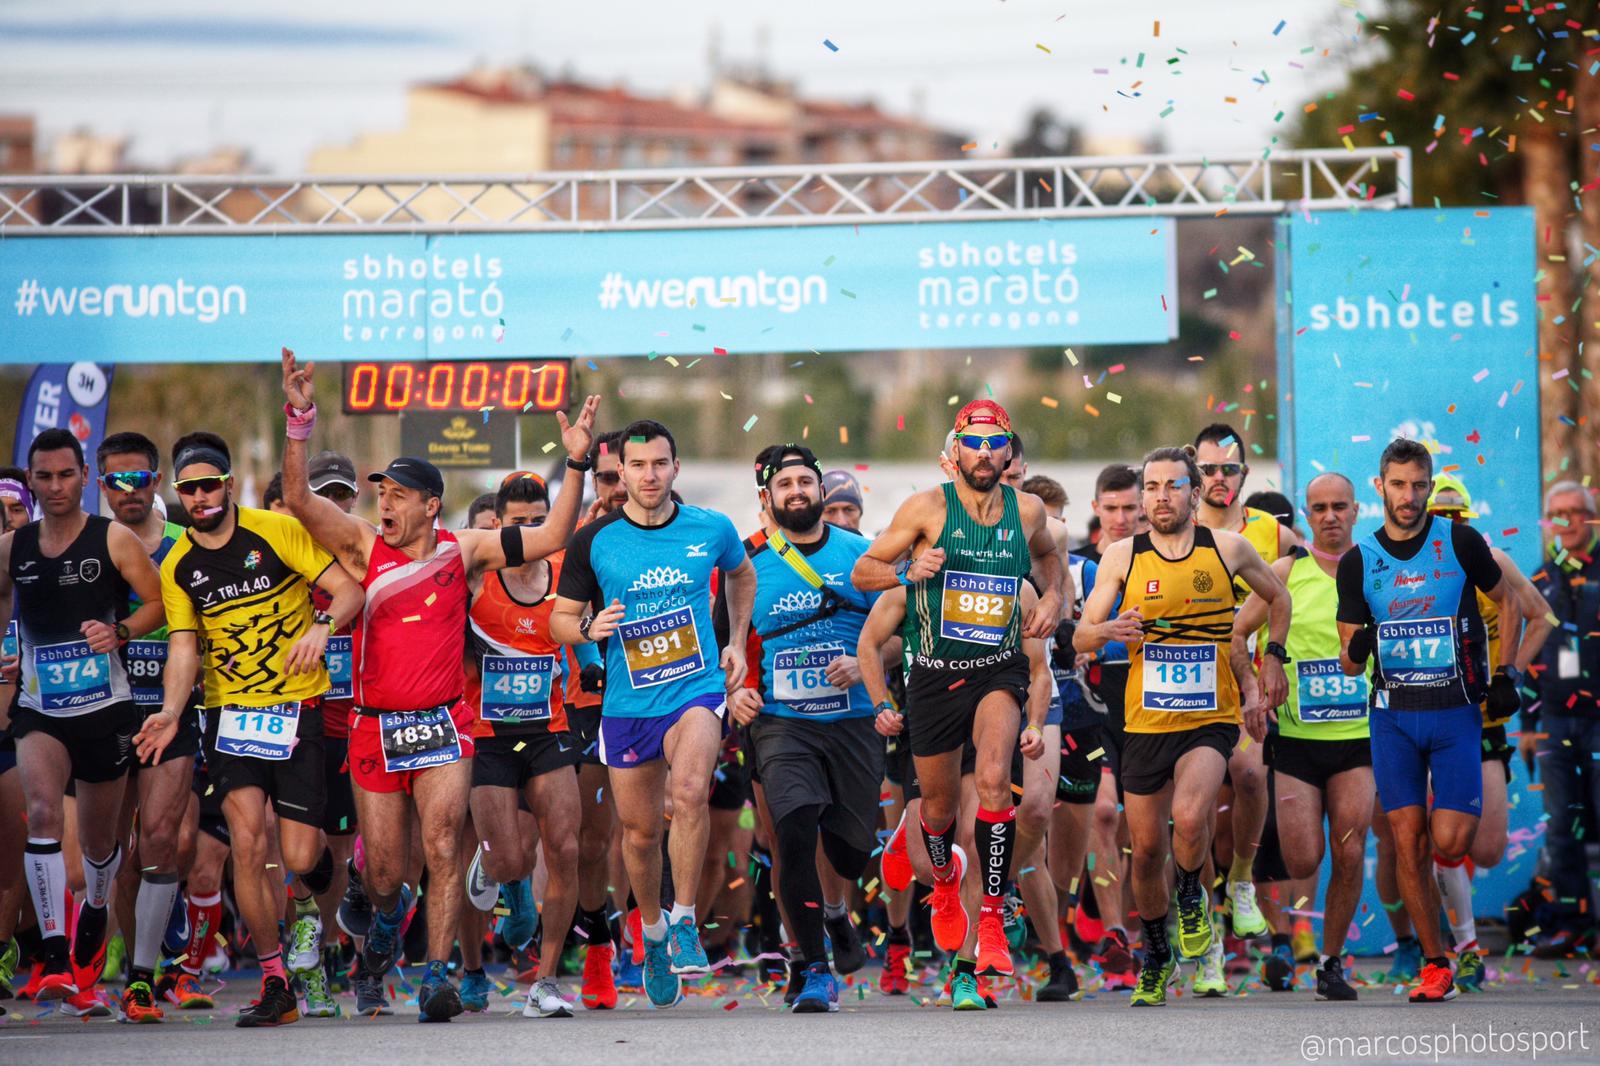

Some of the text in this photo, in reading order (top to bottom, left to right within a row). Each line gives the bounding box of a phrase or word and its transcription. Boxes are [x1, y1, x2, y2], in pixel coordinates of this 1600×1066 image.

[918, 240, 1078, 269] sbhotels
[343, 253, 504, 280] sbhotels
[598, 270, 828, 312] #weruntgn
[918, 266, 1080, 305] marató
[15, 278, 247, 322] #weruntgn
[343, 279, 505, 319] marató
[919, 308, 1080, 330] tarragona
[1309, 292, 1520, 331] sbhotels
[343, 322, 504, 343] tarragona
[350, 363, 566, 409] 00:00:00
[217, 575, 271, 600] TRI-4.40
[951, 576, 1013, 593] sbhotels
[958, 593, 1004, 616] 982
[625, 613, 688, 638] sbhotels
[1382, 622, 1446, 638] sbhotels
[638, 631, 682, 658] 991
[1149, 649, 1210, 660] sbhotels
[1390, 638, 1441, 660] 417
[47, 657, 100, 685] 374
[489, 660, 549, 671] sbhotels
[1156, 663, 1202, 685] 181
[494, 674, 542, 695] 459
[1309, 676, 1358, 698] 835
[234, 713, 285, 735] 118
[392, 723, 445, 746] 1831
